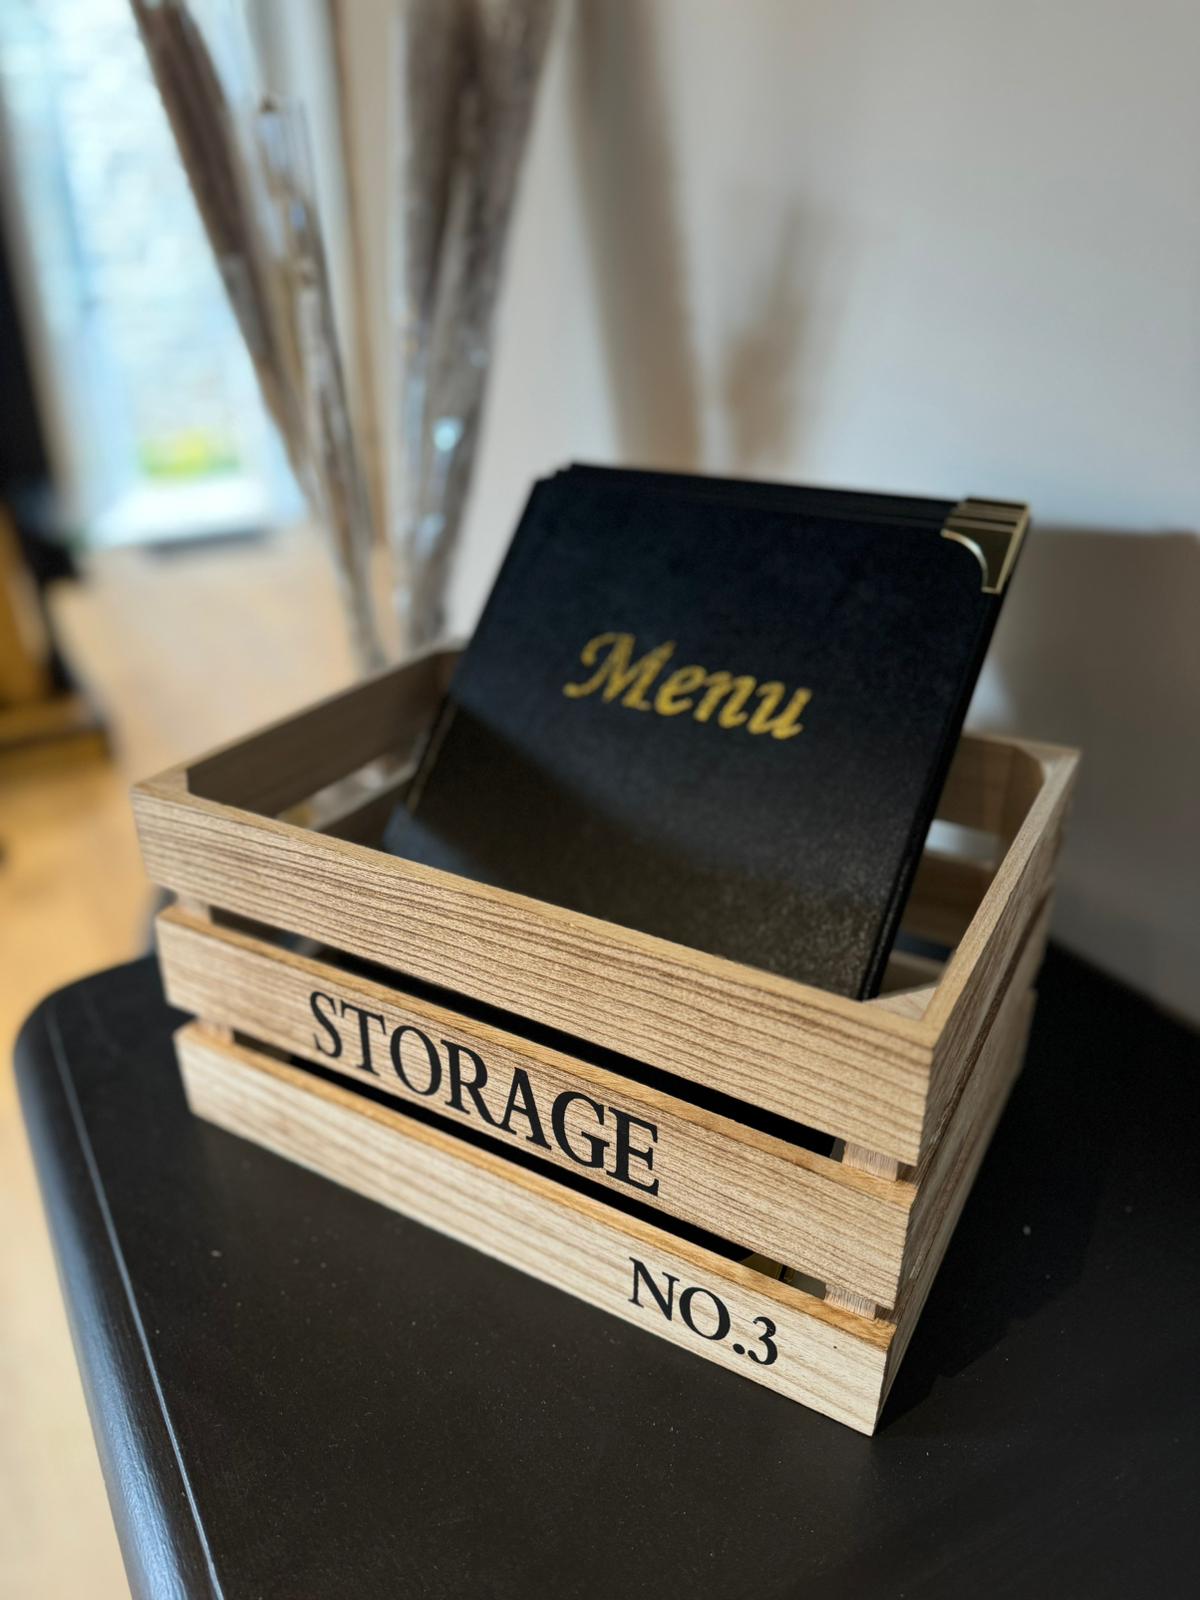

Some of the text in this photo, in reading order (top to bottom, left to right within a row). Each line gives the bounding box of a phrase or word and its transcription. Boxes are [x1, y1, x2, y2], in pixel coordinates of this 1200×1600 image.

[563, 632, 812, 739] Menu
[309, 991, 660, 1196] STORAGE
[628, 1257, 779, 1365] NO.3
